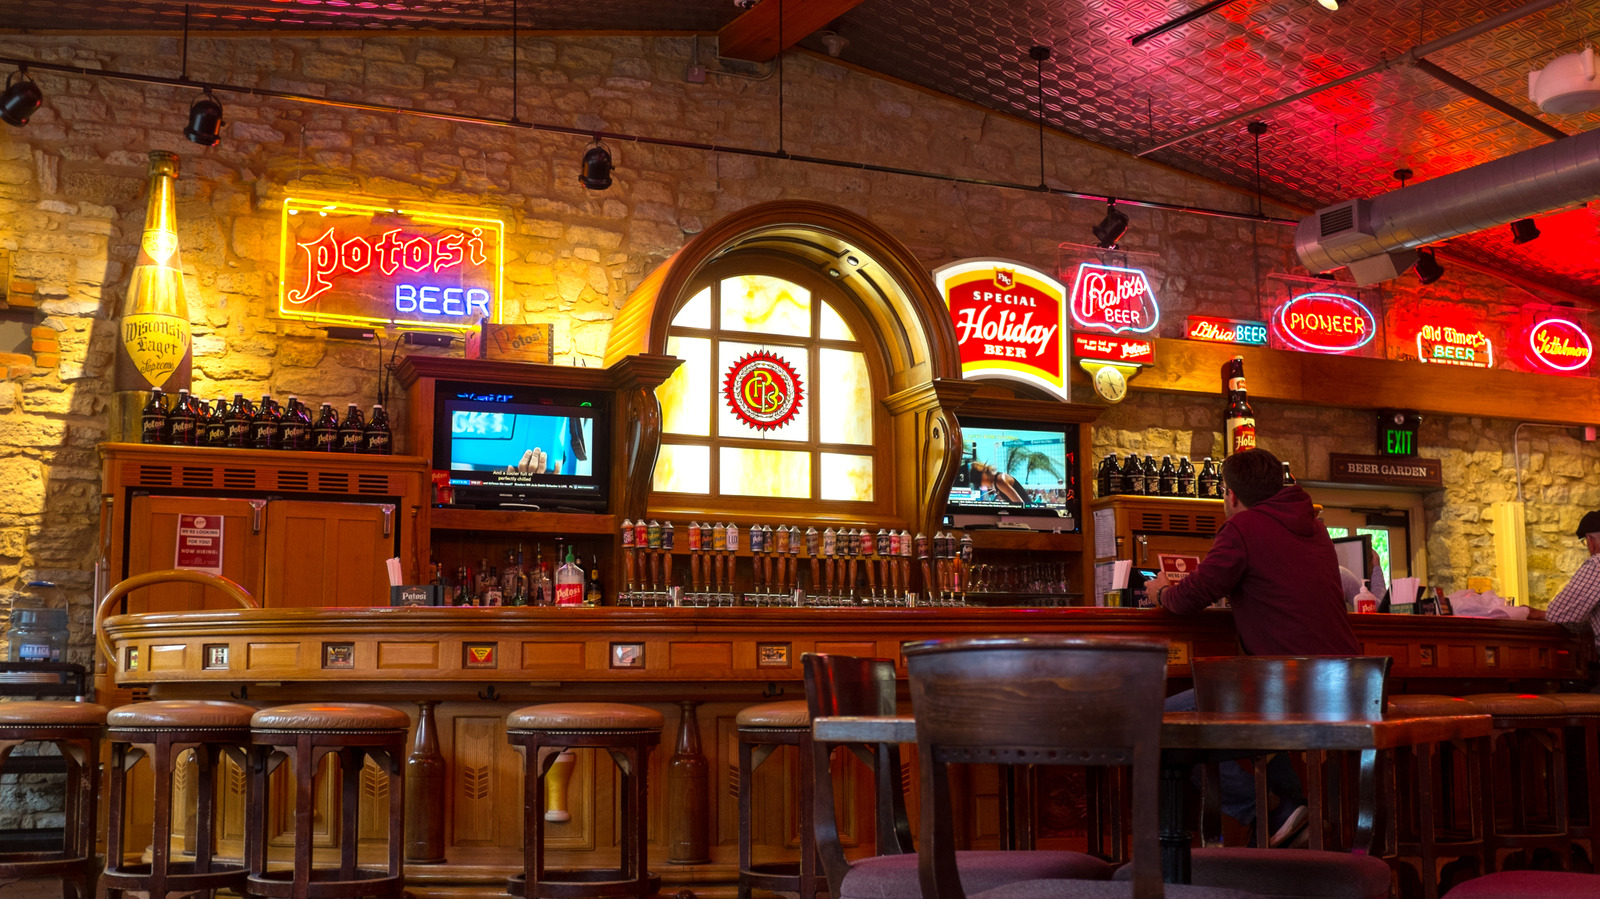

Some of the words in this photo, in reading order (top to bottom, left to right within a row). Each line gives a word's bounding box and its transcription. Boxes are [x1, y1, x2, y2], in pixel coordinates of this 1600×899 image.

[395, 284, 490, 317] BEER
[973, 291, 1036, 307] SPECIAL
[1105, 308, 1140, 324] BEER
[1290, 313, 1364, 334] PIONEER
[125, 320, 187, 347] Wisconsin
[956, 304, 1057, 357] Holiday
[1191, 321, 1235, 341] Lithia
[1236, 325, 1267, 342] BEER
[1422, 325, 1441, 341] Old
[137, 336, 178, 359] Lager
[491, 325, 543, 354] Potosi
[984, 344, 1027, 358] BEER
[1433, 345, 1474, 361] BEER
[143, 418, 165, 434] Potosi
[173, 421, 194, 436] Potosi
[209, 428, 225, 441] Poto
[1387, 430, 1413, 454] EXIT
[1348, 463, 1379, 474] BEER
[1381, 465, 1427, 477] GARDEN
[402, 591, 426, 600] Potosi
[556, 586, 580, 602] Potosi
